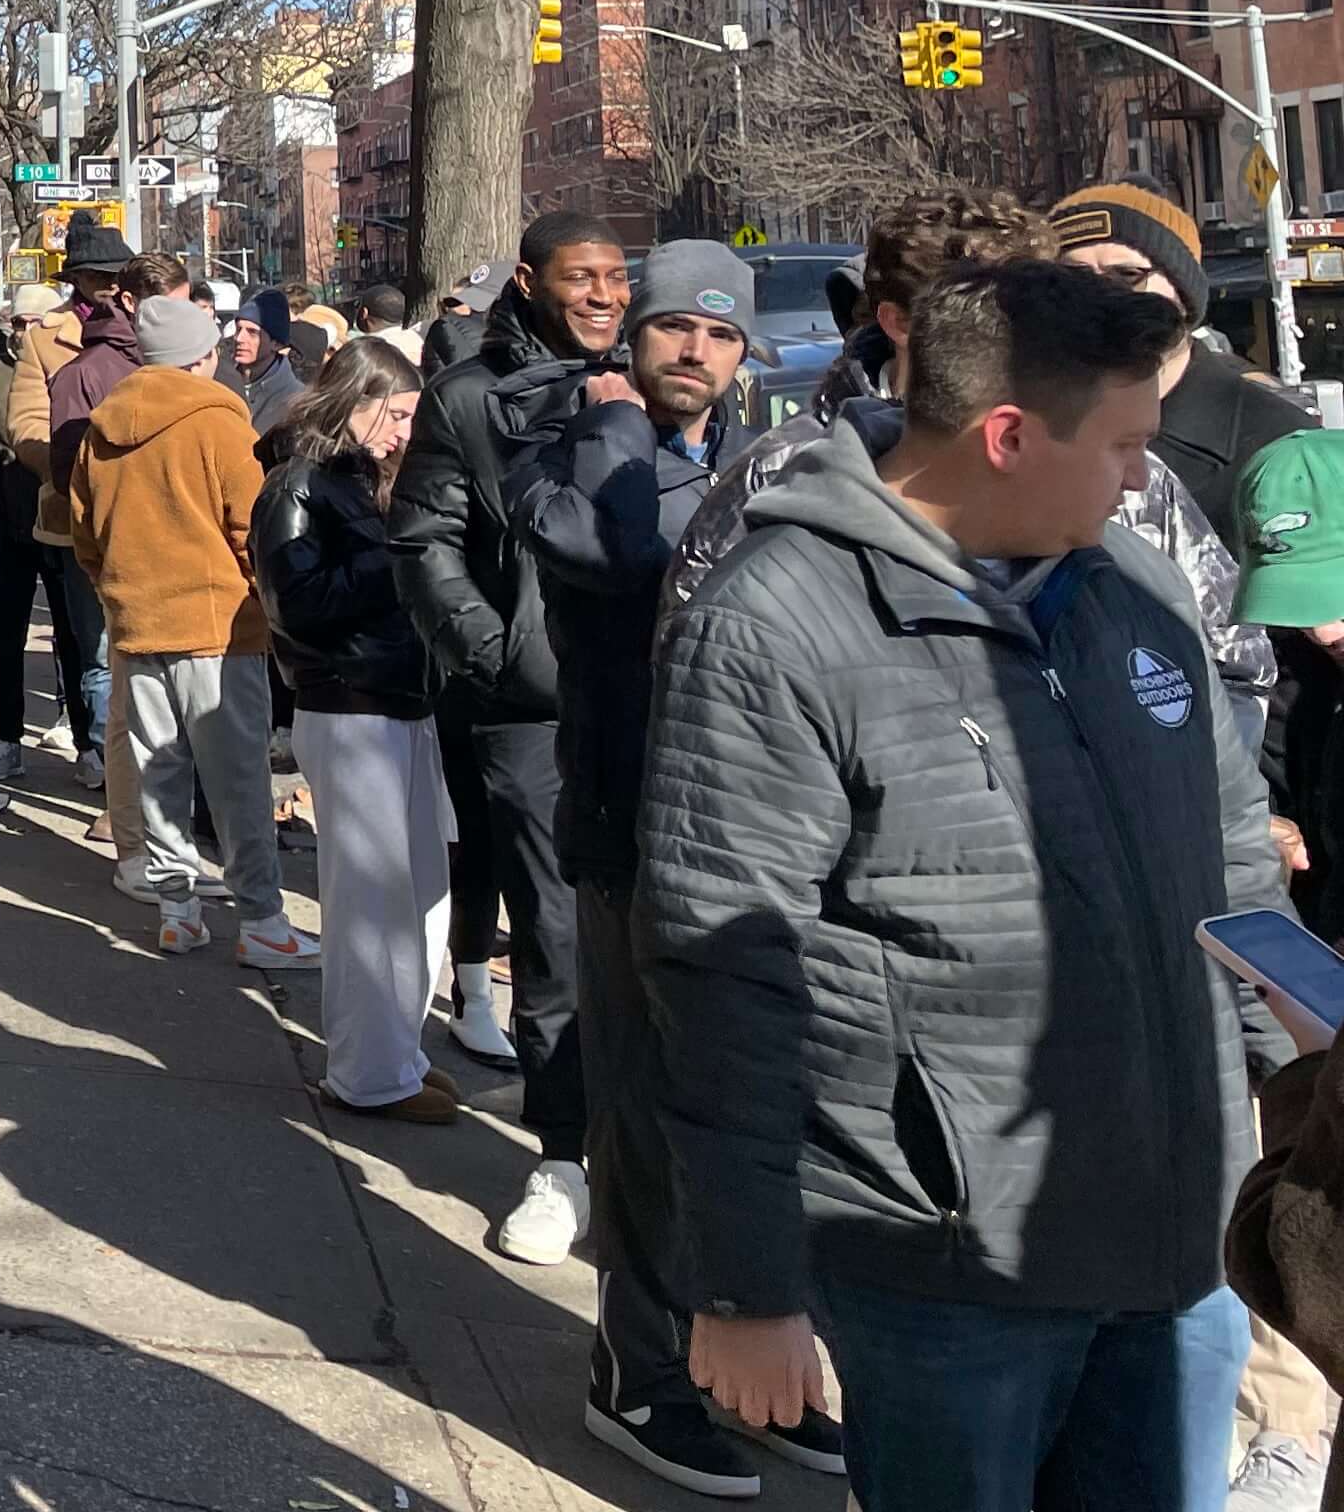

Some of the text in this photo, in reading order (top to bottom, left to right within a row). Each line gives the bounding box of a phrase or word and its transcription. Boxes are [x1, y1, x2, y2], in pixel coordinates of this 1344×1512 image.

[18, 167, 25, 178] E
[29, 167, 41, 178] 10
[69, 189, 86, 197] WAY
[1299, 224, 1315, 236] 10
[1137, 682, 1193, 706] OUTDOORS
